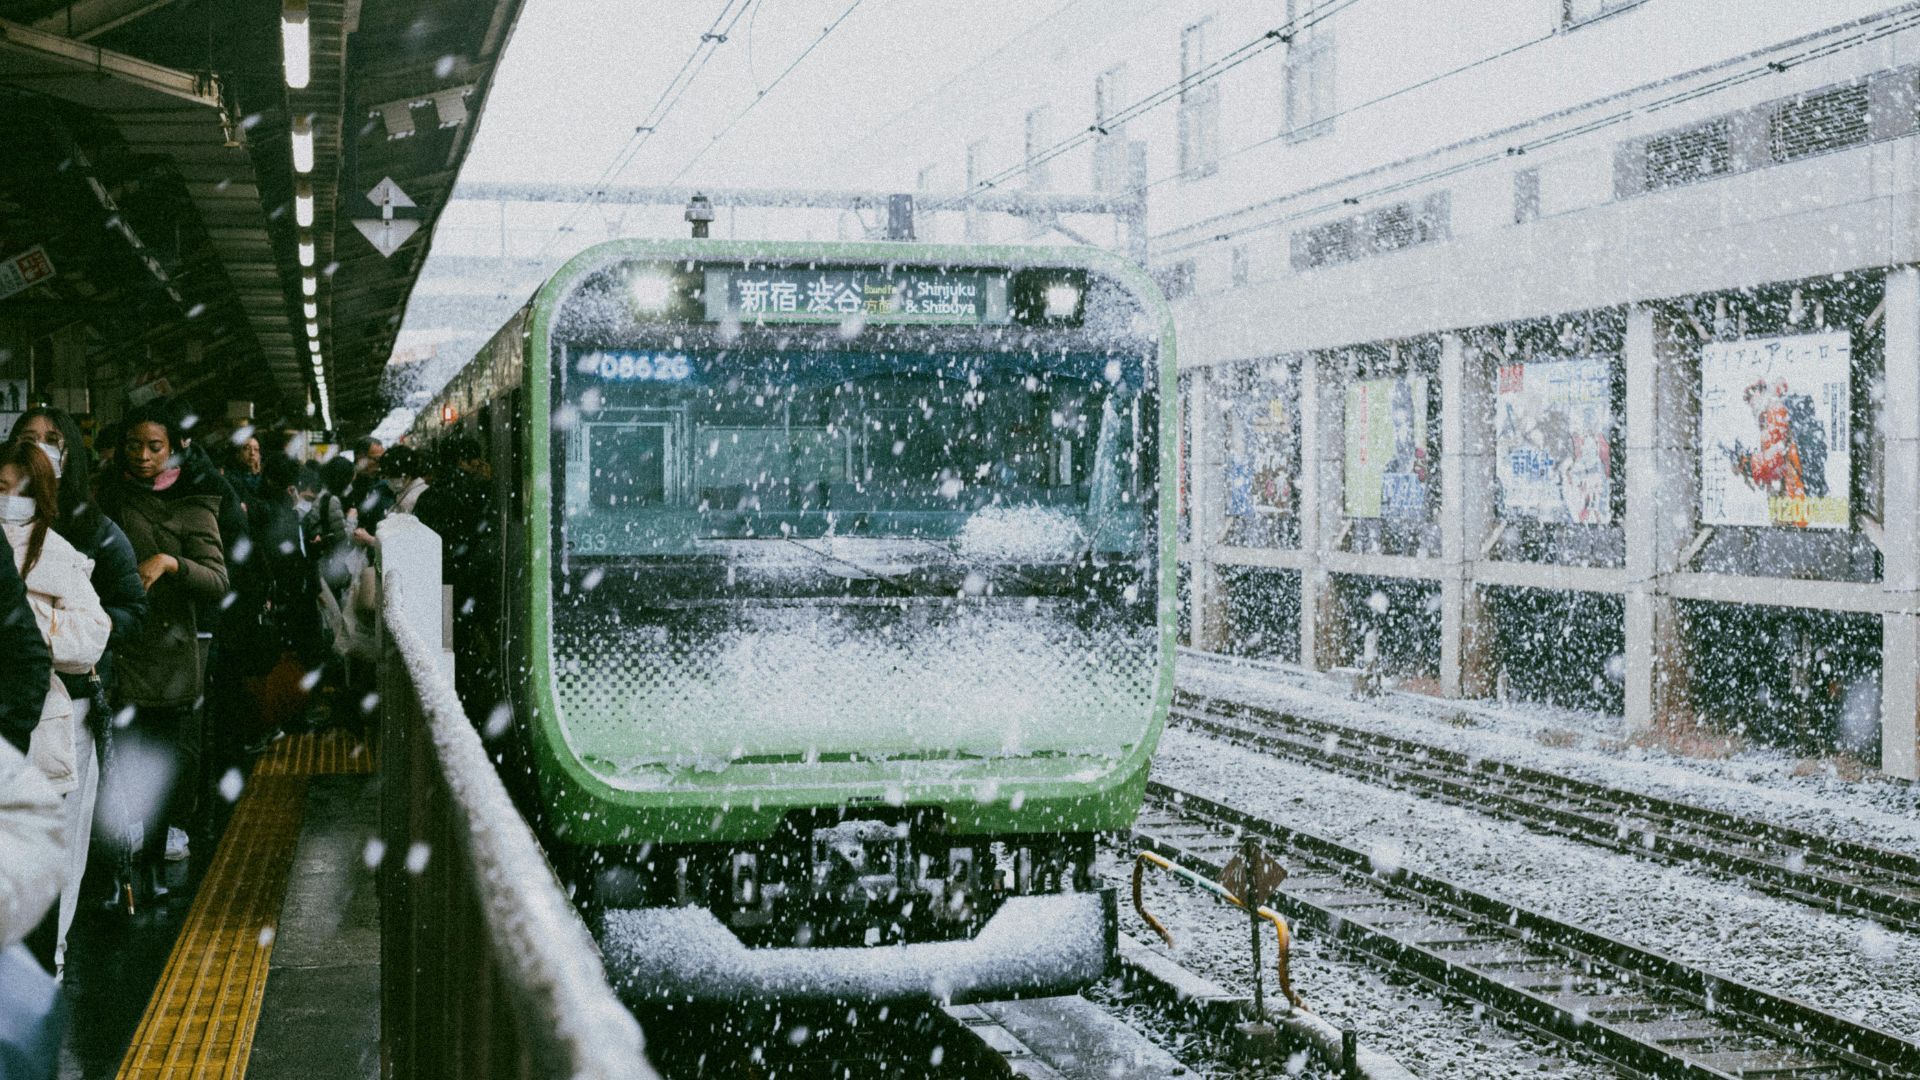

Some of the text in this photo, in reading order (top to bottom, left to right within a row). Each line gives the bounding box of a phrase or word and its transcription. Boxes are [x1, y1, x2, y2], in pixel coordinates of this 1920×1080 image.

[917, 281, 975, 298] Shinjuku
[906, 300, 975, 316] & Shibuya
